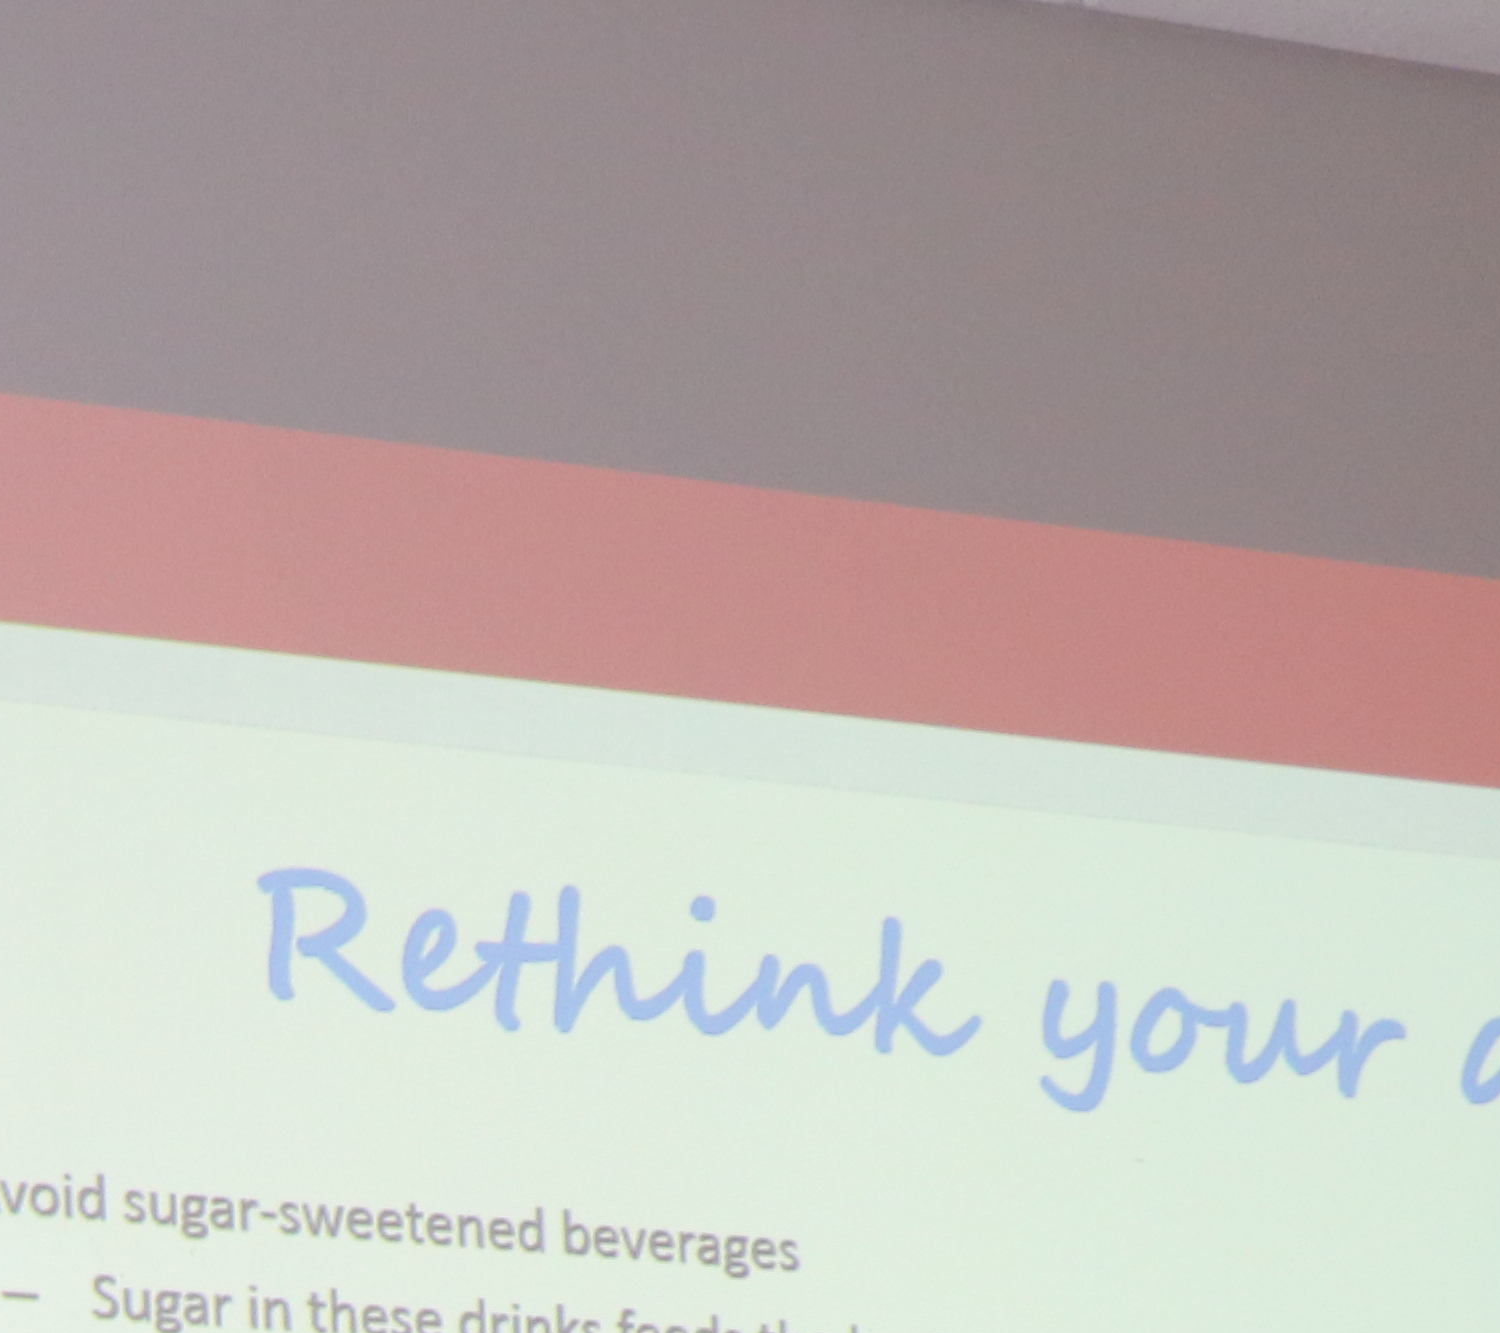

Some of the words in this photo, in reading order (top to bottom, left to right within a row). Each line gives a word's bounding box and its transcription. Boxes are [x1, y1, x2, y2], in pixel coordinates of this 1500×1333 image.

[258, 868, 982, 1057] Rethink
[1041, 980, 1406, 1112] your
[121, 1189, 545, 1255] sugar-sweetened
[559, 1208, 801, 1281] beverages
[246, 1285, 292, 1333] in
